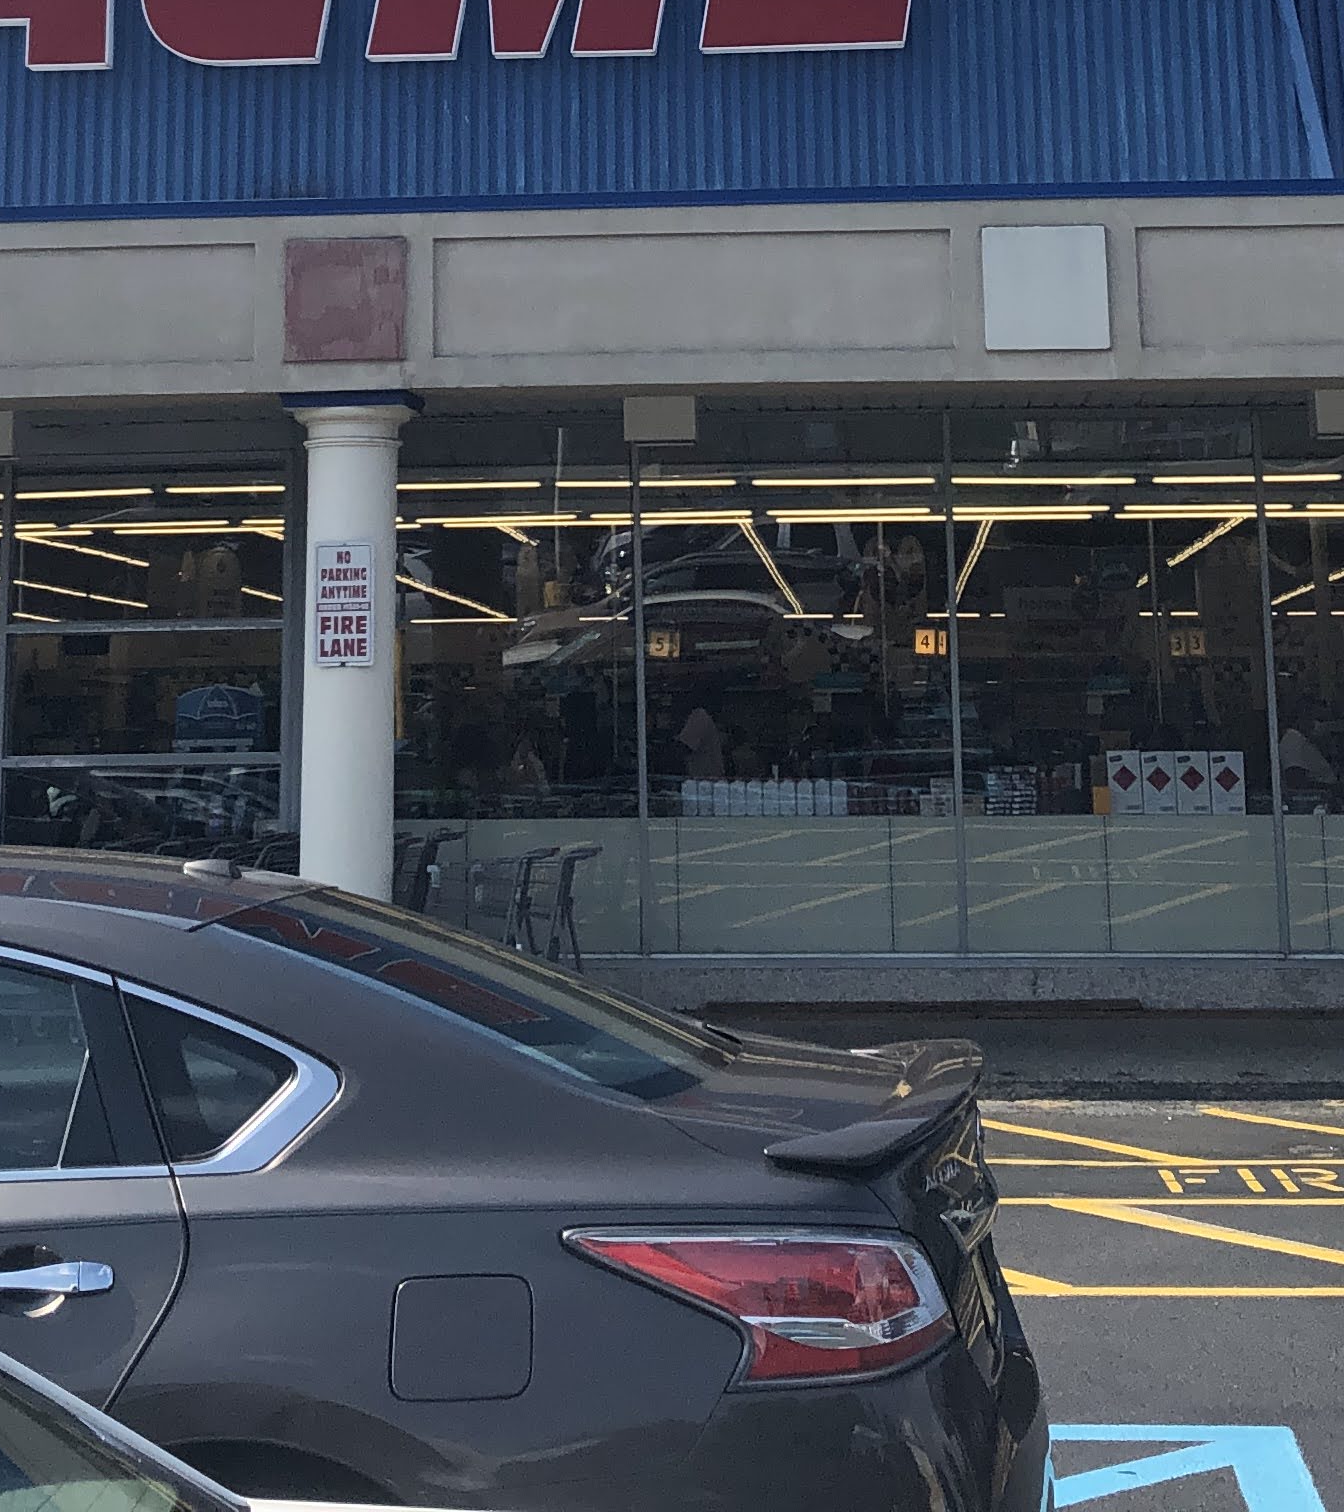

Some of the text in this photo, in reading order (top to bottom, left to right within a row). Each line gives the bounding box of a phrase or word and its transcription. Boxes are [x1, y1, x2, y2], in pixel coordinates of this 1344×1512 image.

[336, 550, 351, 564] NO
[320, 567, 367, 582] PARKING
[320, 584, 367, 599] ANYTIME
[319, 615, 368, 635] FIRE
[319, 637, 368, 658] LANE
[920, 634, 931, 649] 4
